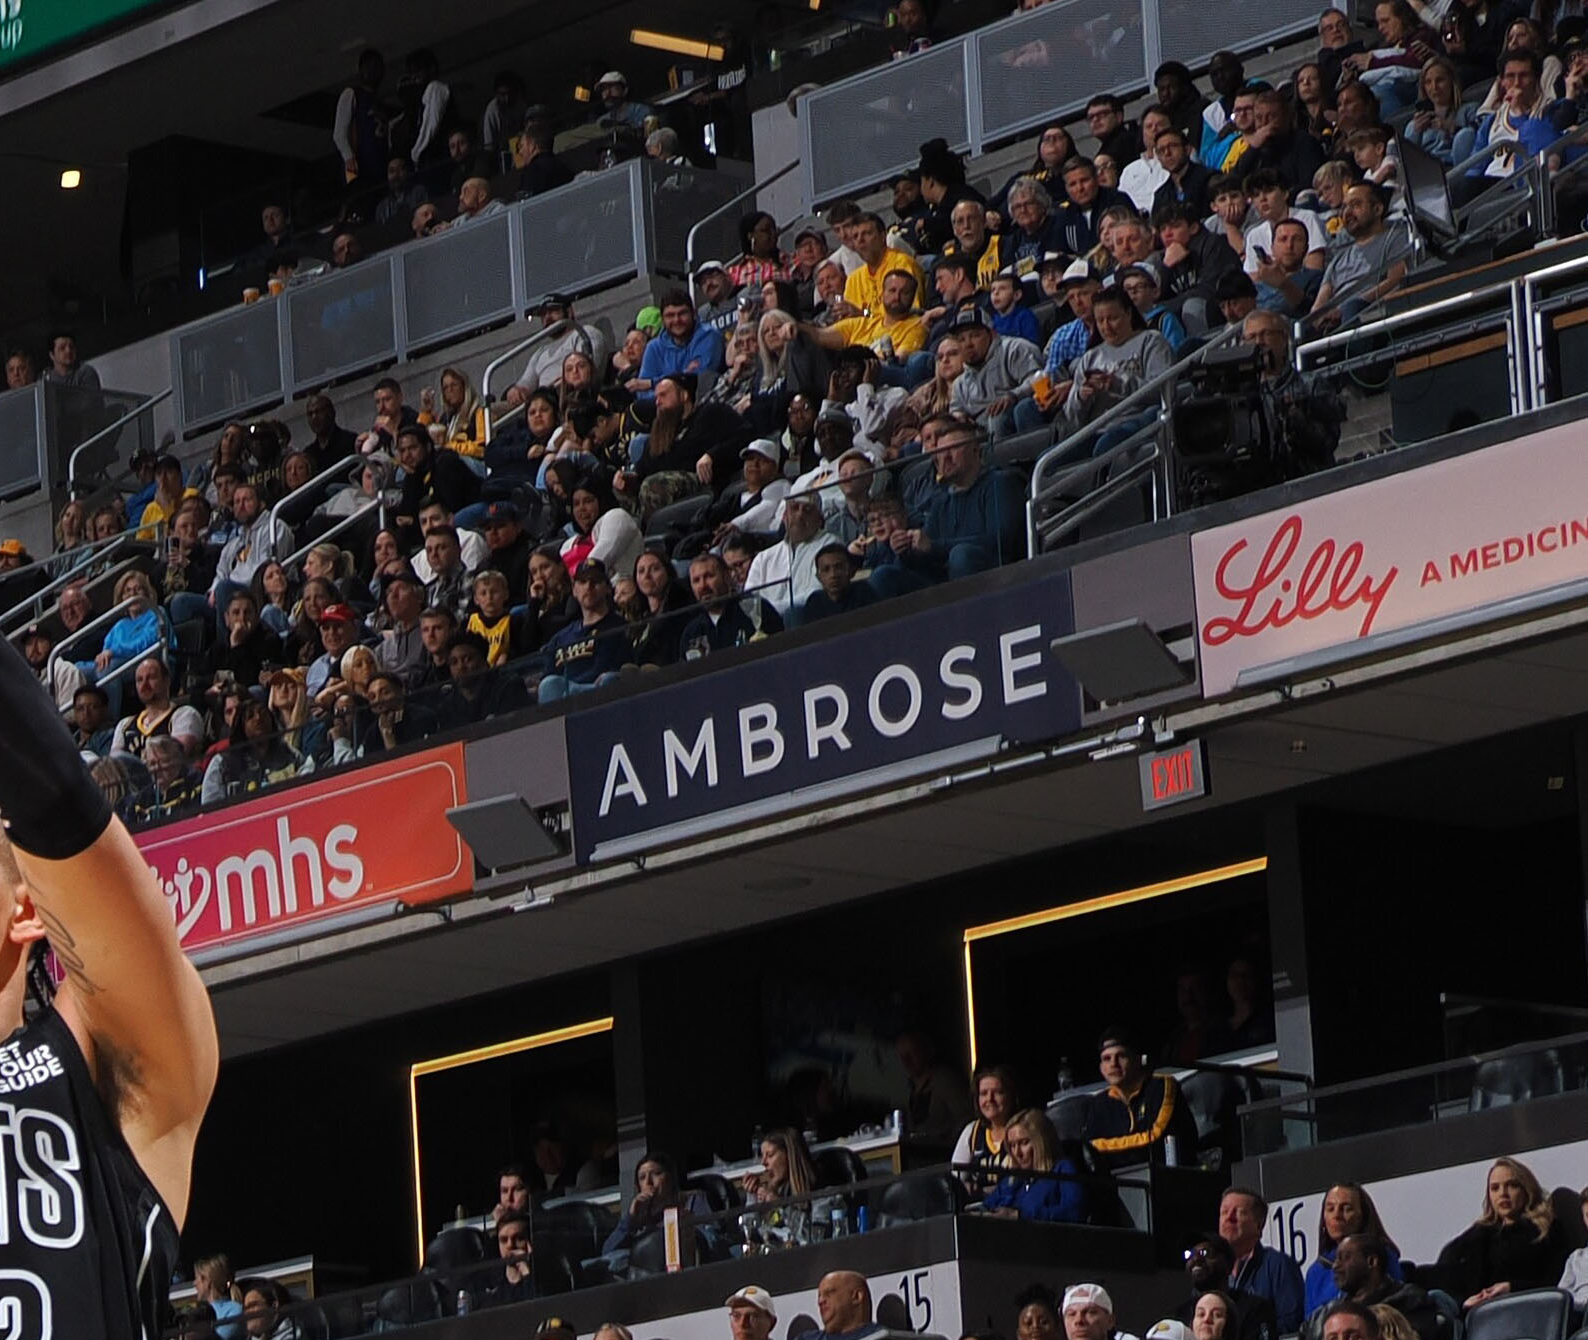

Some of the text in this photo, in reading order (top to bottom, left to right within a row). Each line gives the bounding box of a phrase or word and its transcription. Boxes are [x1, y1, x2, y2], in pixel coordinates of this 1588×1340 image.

[1203, 515, 1588, 647] Lilly A MEDICIN
[596, 624, 1047, 817] AMBROSE
[1150, 751, 1193, 799] EXIT
[215, 815, 364, 931] mhs
[1274, 1202, 1309, 1268] 16
[900, 1270, 932, 1332] 15
